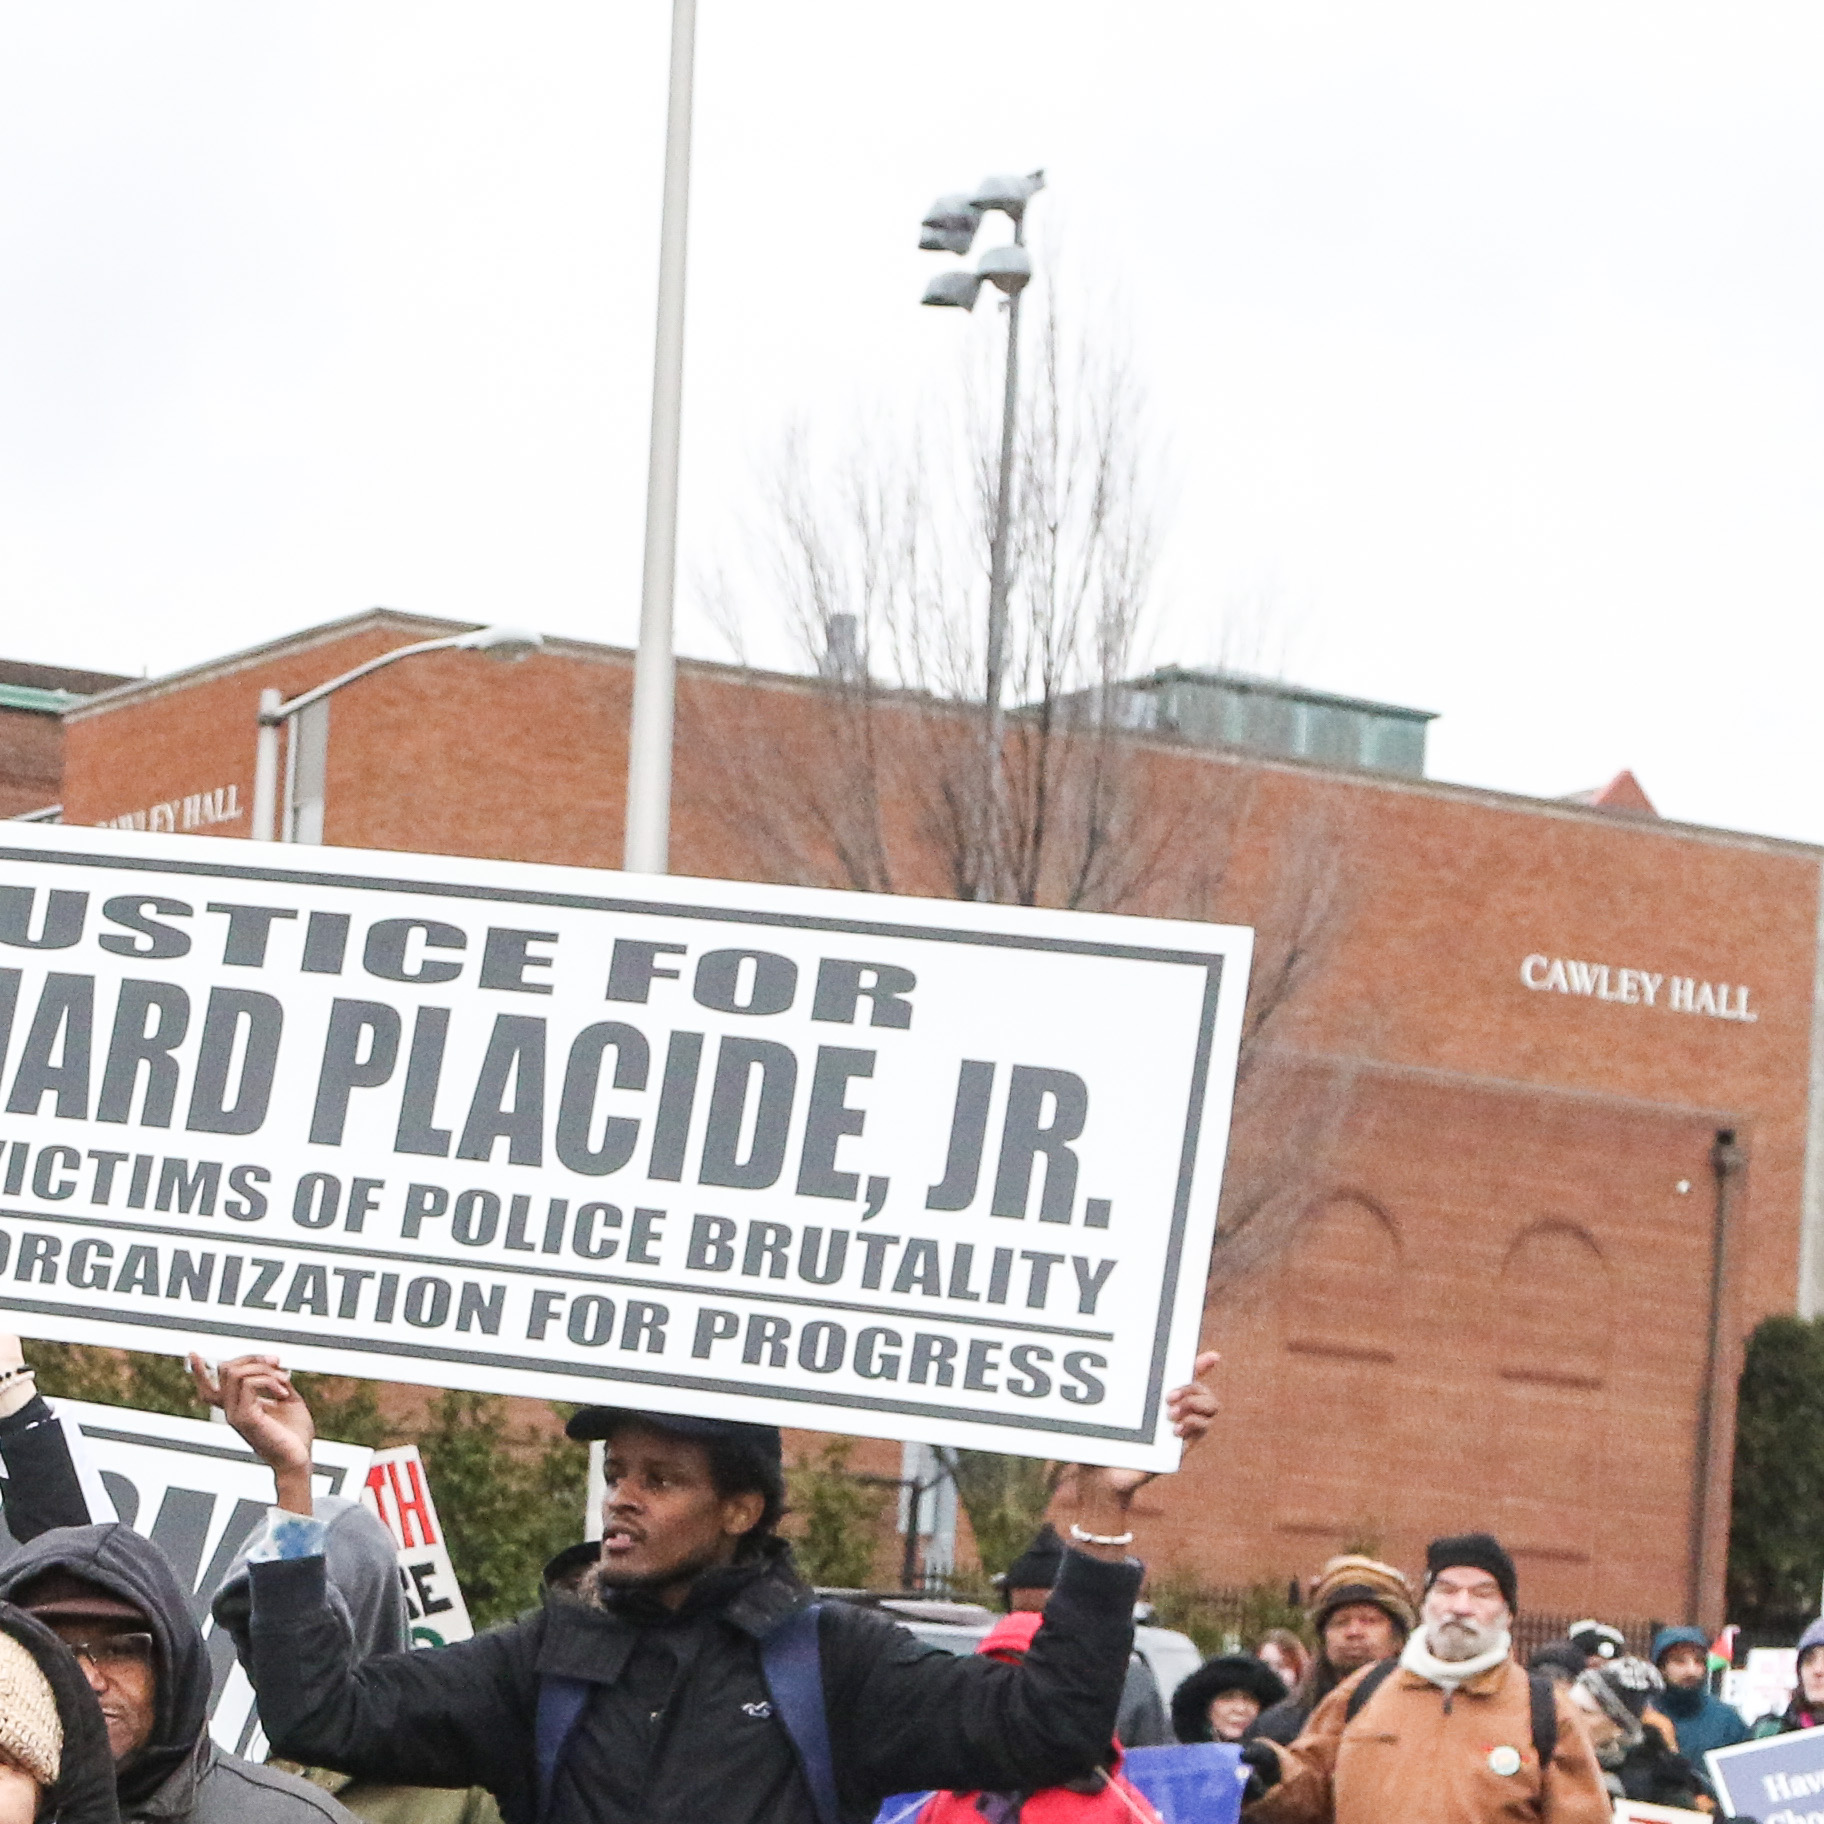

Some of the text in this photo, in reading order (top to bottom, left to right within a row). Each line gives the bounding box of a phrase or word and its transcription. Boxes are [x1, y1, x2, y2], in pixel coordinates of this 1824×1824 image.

[183, 784, 243, 829] HALL
[604, 937, 917, 1031] FOR
[1520, 954, 1758, 1022] CAWLEY HALL
[307, 997, 890, 1213] PLACIDE,
[924, 1058, 1112, 1230] JR.
[291, 1171, 386, 1234] OF
[399, 1182, 668, 1267] POLICE
[684, 1213, 1117, 1316] BRUTALITY
[525, 1288, 670, 1355] FOR
[690, 1307, 1108, 1406] PROGRESS
[1761, 1769, 1824, 1802] Hav
